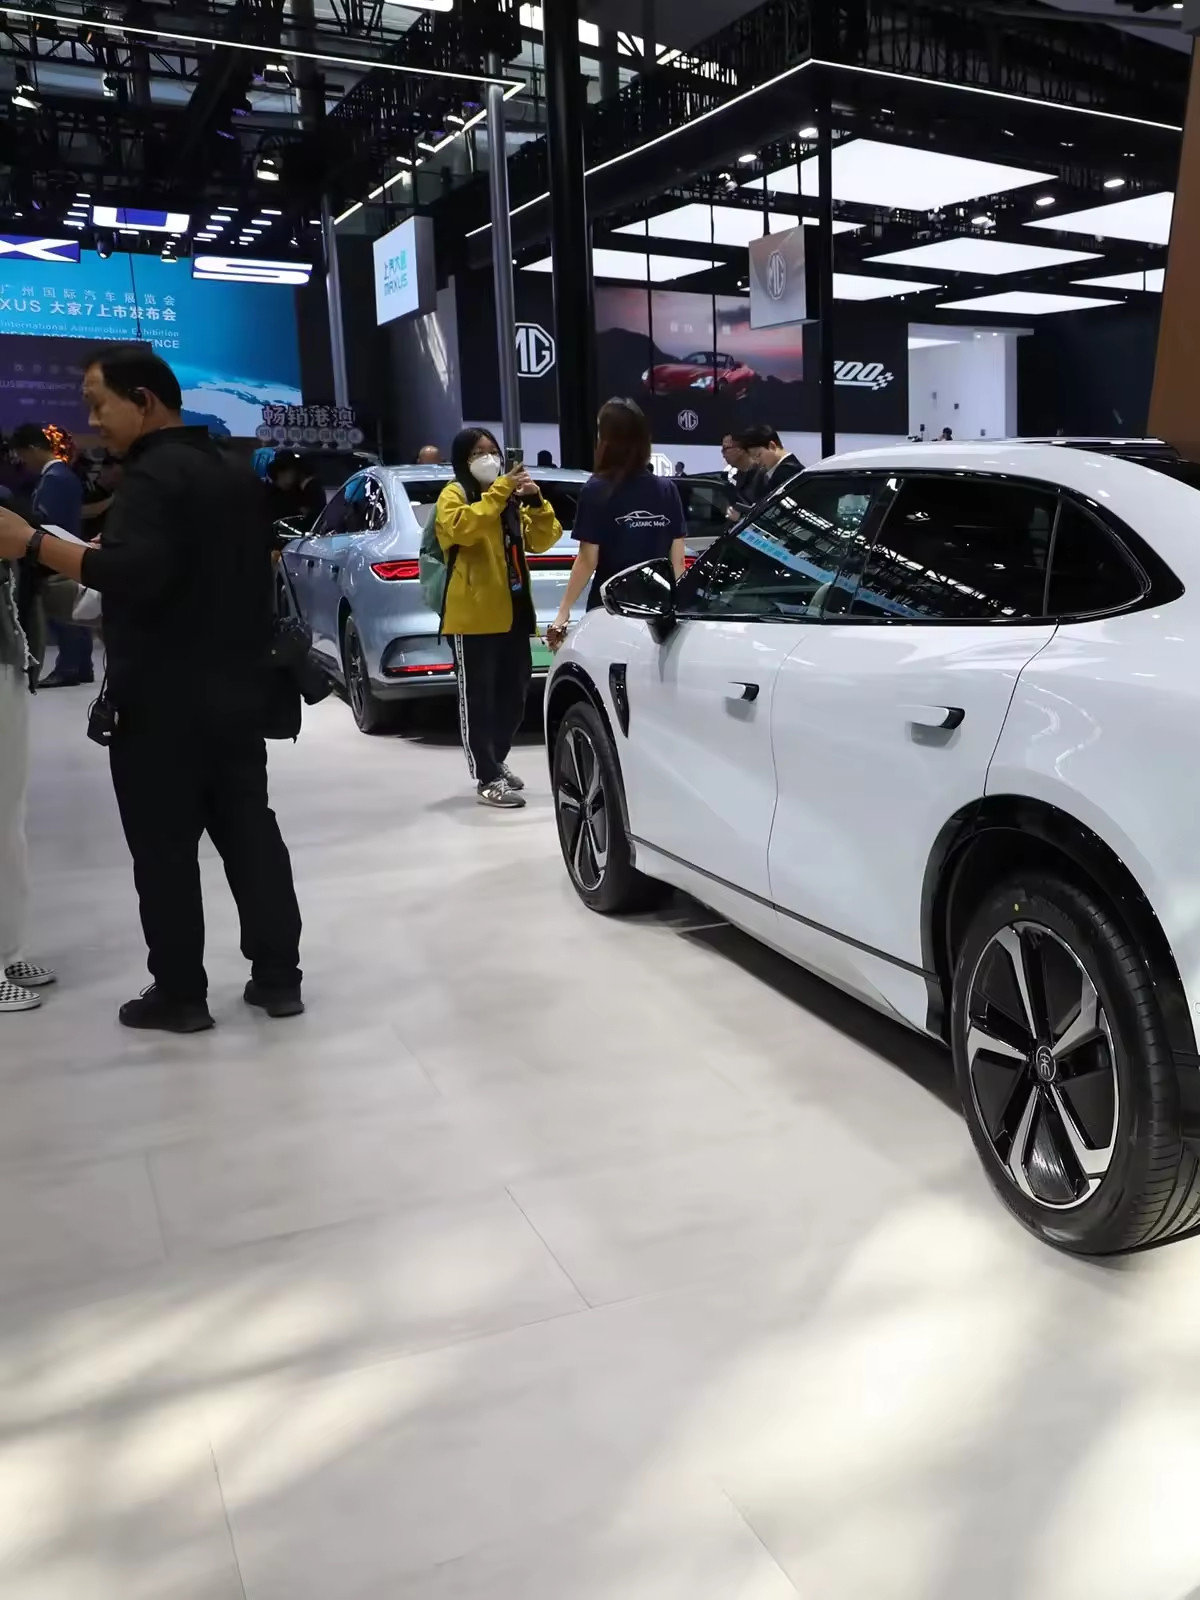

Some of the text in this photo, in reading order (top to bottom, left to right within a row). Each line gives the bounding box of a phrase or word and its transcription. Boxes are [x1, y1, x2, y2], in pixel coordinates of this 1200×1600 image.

[51, 301, 177, 322] 大家7上市发布会
[131, 328, 179, 338] Ehibition
[679, 411, 698, 430] MG
